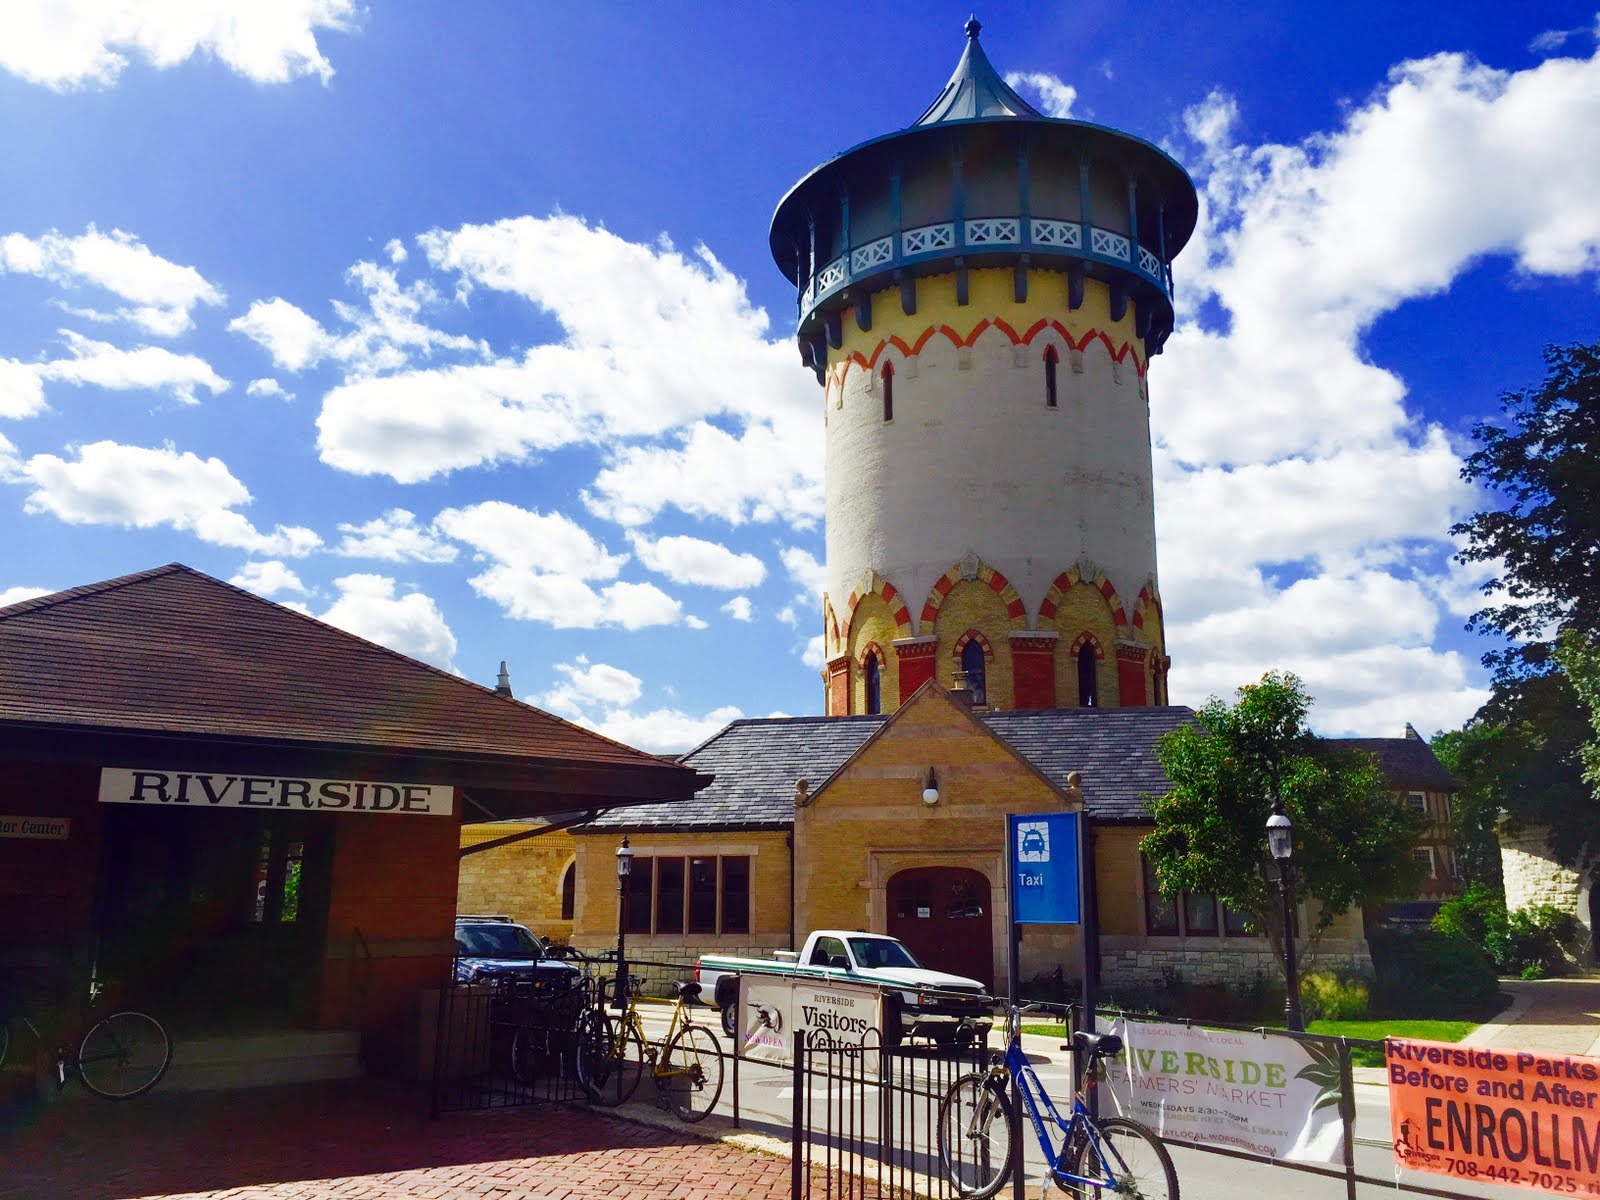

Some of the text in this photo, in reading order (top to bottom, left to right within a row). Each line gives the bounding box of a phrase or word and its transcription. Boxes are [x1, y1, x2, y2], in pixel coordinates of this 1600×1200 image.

[128, 772, 431, 813] RIVERSIDE
[22, 820, 65, 835] Center
[1018, 873, 1043, 886] Taxi
[814, 994, 855, 1008] RIVERSIDE
[802, 1005, 867, 1034] Visitors
[763, 1036, 783, 1048] OPEN
[806, 1030, 863, 1058] Center
[1217, 1037, 1245, 1046] LOCAL
[1388, 1040, 1598, 1081] Riverside Parks
[1390, 1063, 1598, 1109] Before and After
[1201, 1115, 1225, 1124] NEXT
[1252, 1126, 1289, 1137] LIBRARY
[1425, 1096, 1600, 1174] ENROLLM
[1445, 1157, 1577, 1193] 708-442-7025
